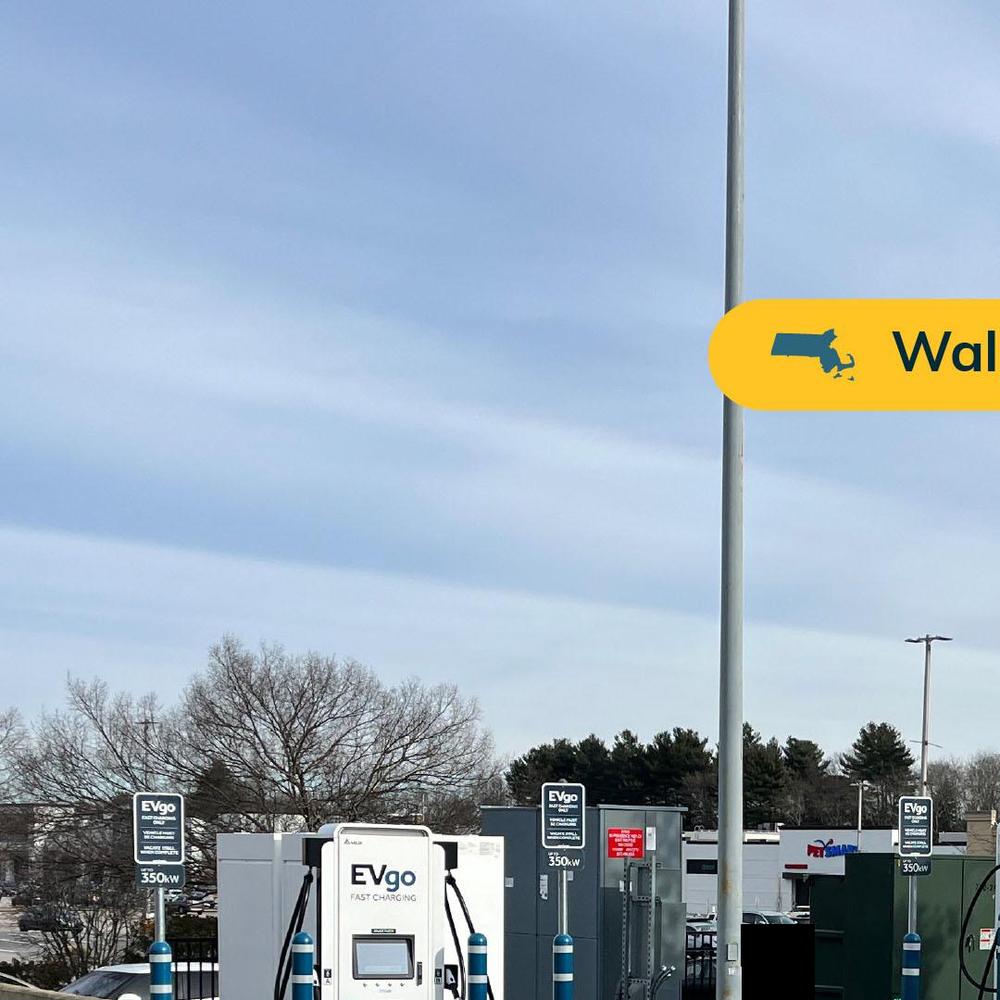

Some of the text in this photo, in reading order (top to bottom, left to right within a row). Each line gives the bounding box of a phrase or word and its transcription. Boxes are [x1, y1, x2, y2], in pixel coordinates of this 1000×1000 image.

[548, 790, 578, 804] EVgo
[141, 800, 176, 816] EVgo
[903, 802, 928, 816] EVgo
[140, 872, 180, 884] 350kW
[351, 864, 417, 893] EVgo
[350, 893, 417, 902] FAST CHARGING
